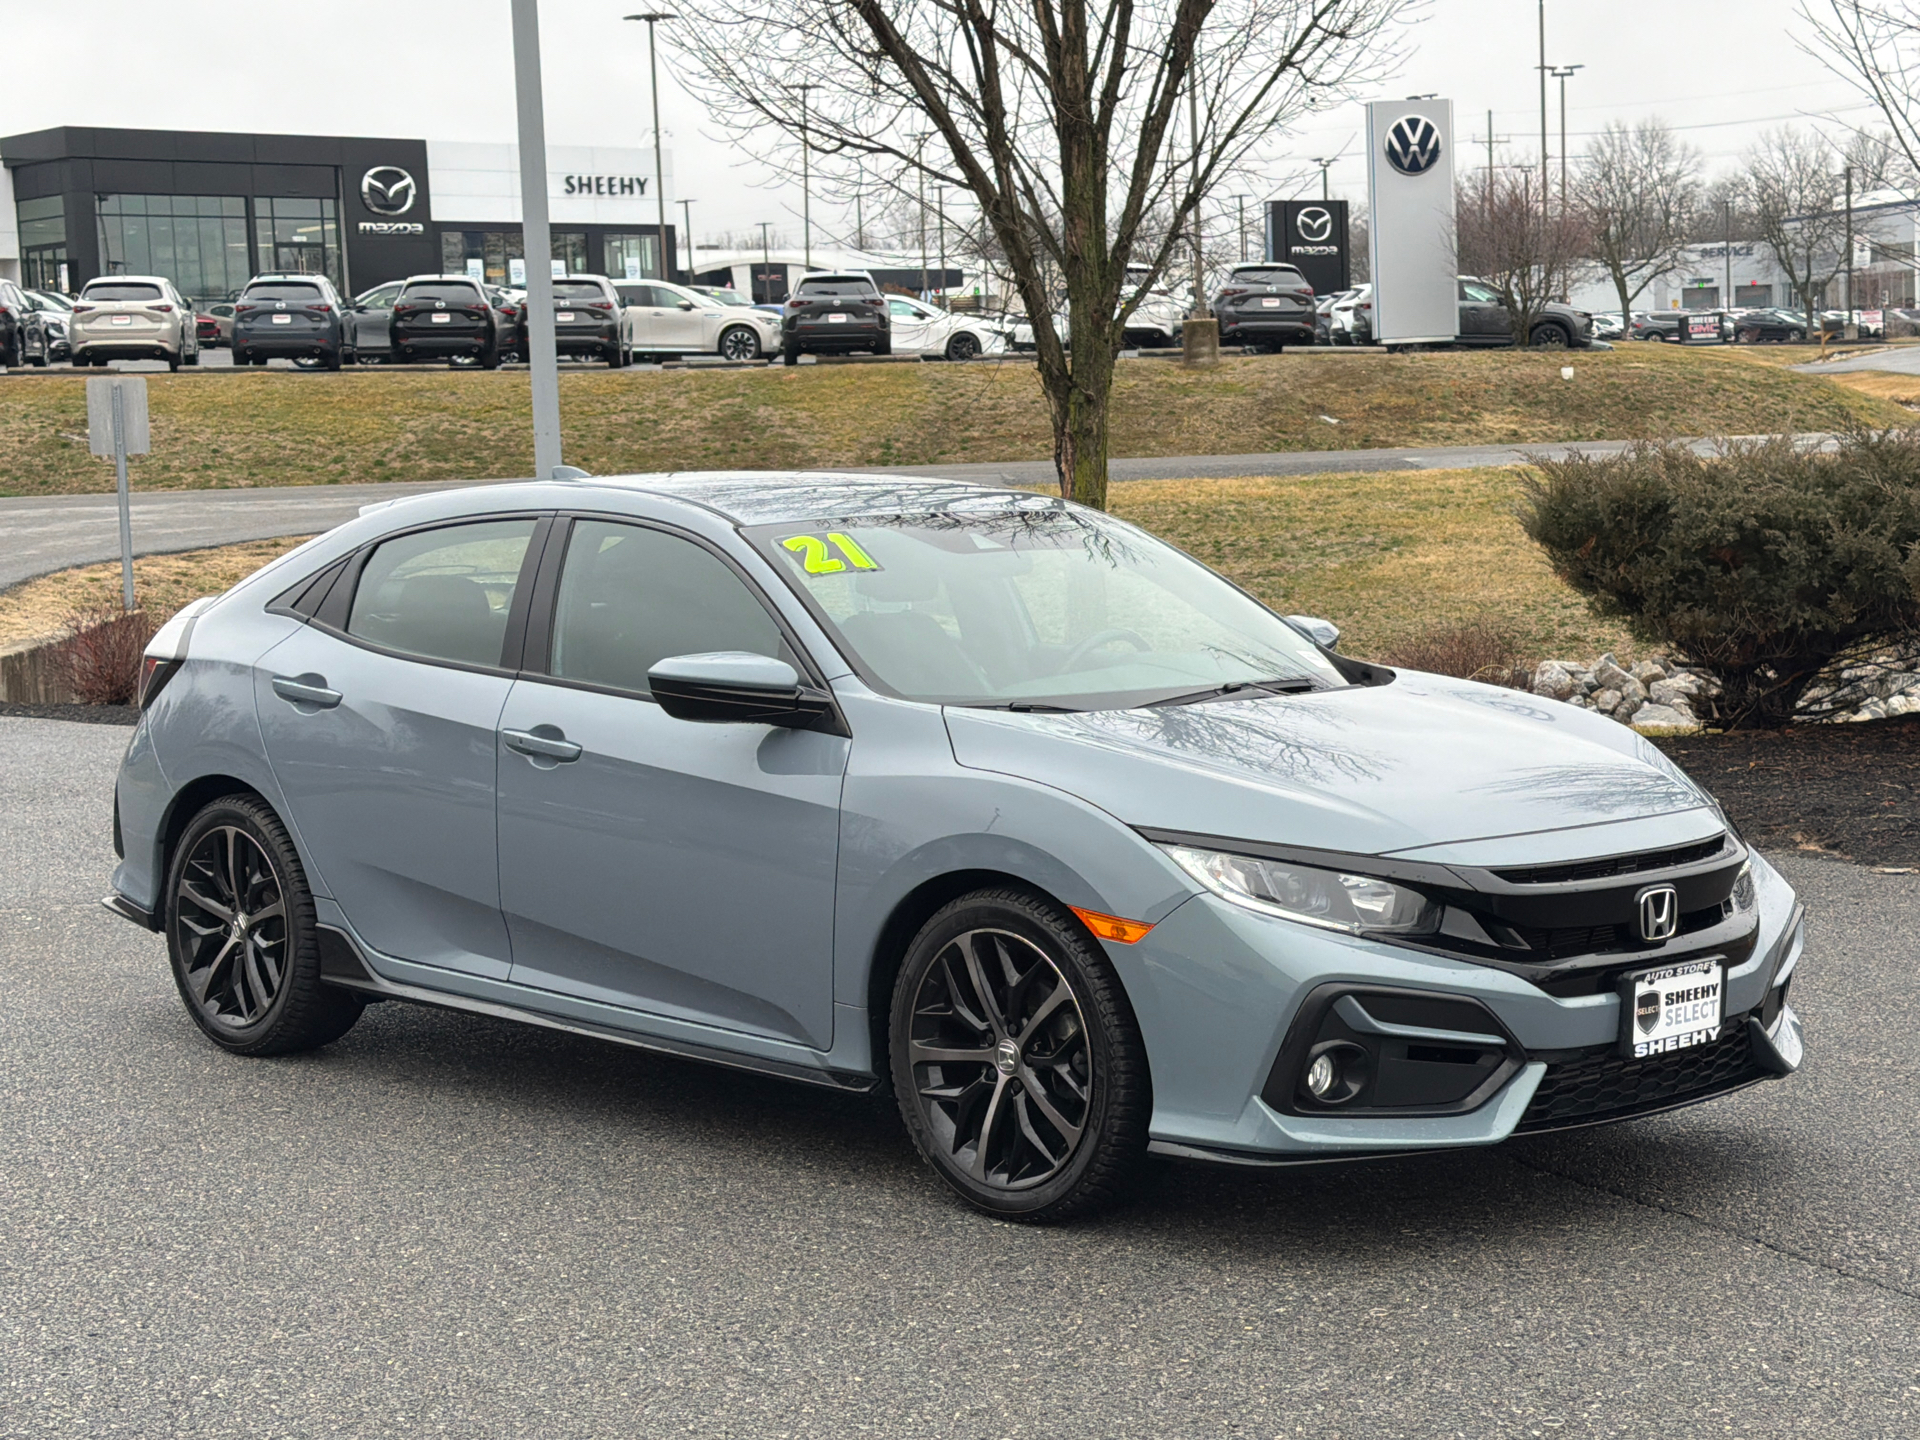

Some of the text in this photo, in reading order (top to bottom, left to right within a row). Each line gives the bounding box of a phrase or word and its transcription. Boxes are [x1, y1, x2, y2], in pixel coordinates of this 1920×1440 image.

[564, 175, 648, 196] SHEEHY
[1688, 324, 1720, 334] GMC
[782, 533, 878, 574] 21
[1643, 961, 1717, 983] AUTO STORES
[1665, 982, 1719, 1007] SHEEHY
[1637, 1004, 1660, 1016] SELECT
[1664, 1000, 1719, 1027] SELECT
[1634, 1025, 1722, 1058] SHEEHY
